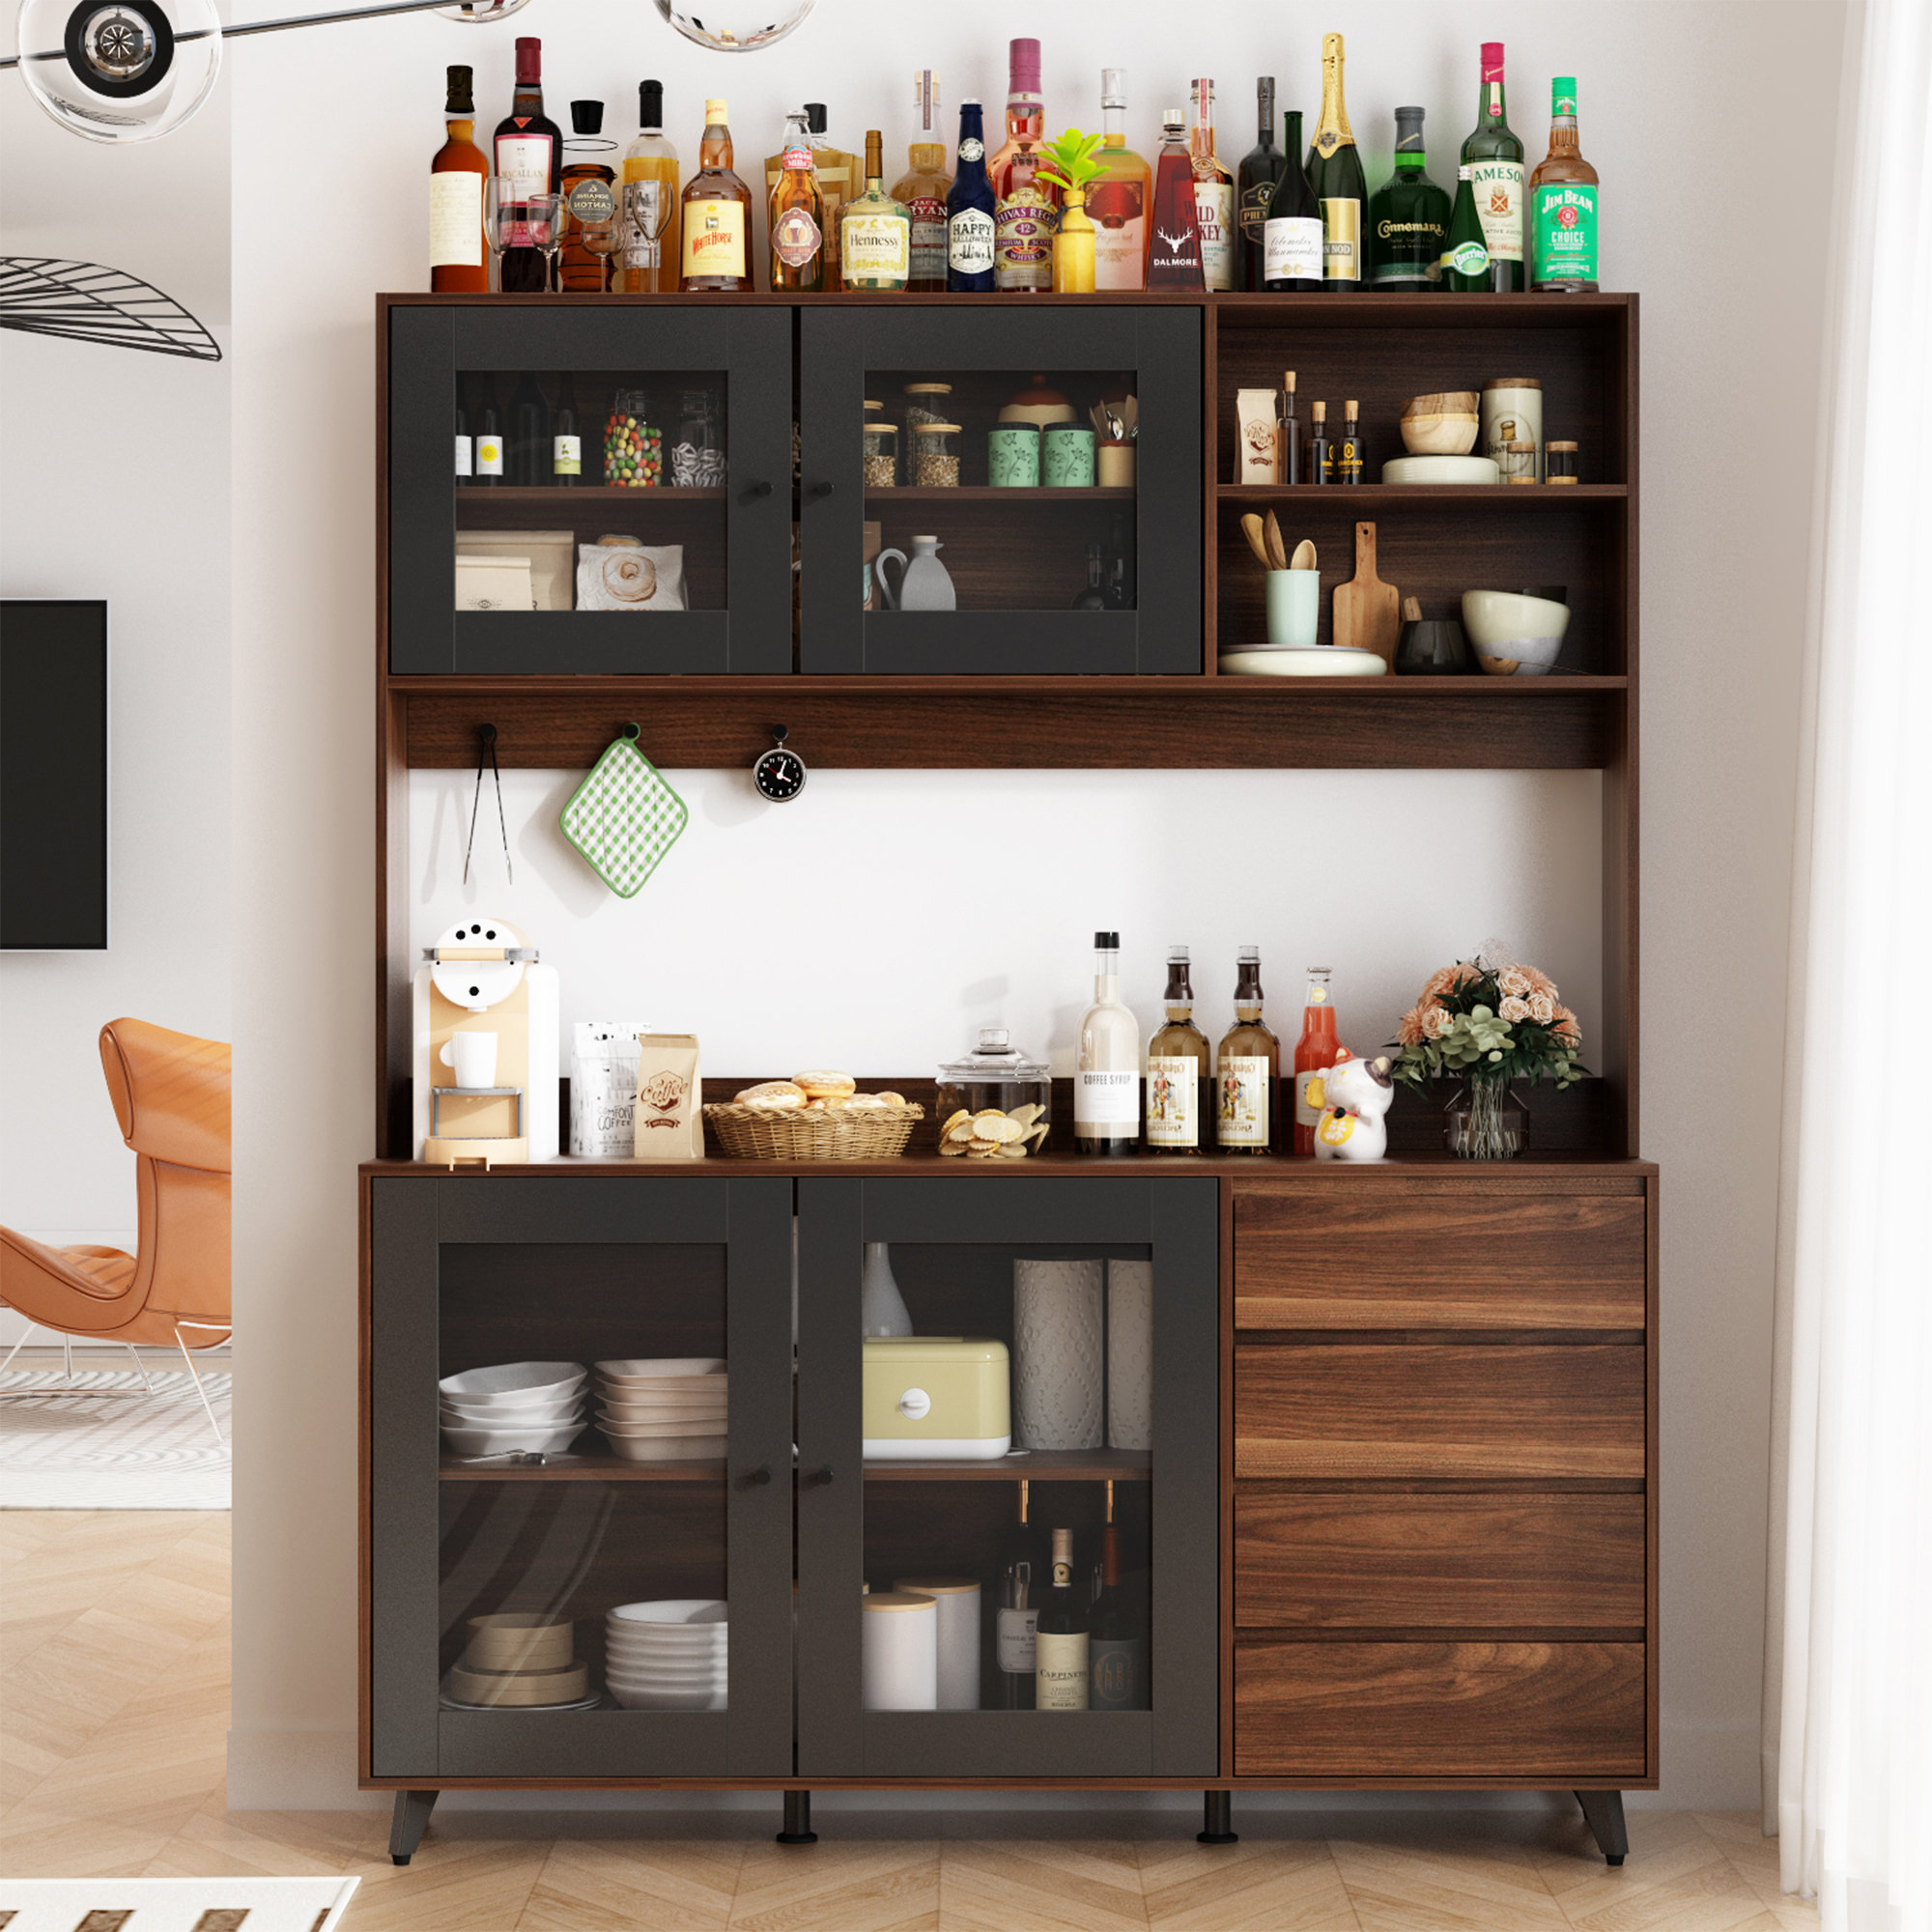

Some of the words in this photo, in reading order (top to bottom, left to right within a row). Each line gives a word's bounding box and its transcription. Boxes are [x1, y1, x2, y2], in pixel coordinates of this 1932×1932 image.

[1473, 166, 1523, 185] AMESO
[1542, 194, 1562, 213] JIM
[1564, 189, 1593, 213] BEAM
[996, 208, 1026, 227] HIVAS
[952, 224, 992, 236] HAPPY
[1020, 224, 1032, 233] 12
[1377, 219, 1445, 240] Connemara
[693, 236, 711, 255] WHITE
[712, 231, 733, 245] HORSE
[850, 234, 899, 249] Hennessy
[1551, 231, 1585, 243] CHOICE
[1010, 252, 1041, 262] WHISKY
[1332, 244, 1351, 255] NOD
[1153, 258, 1199, 268] DALMORE
[1083, 1074, 1108, 1086] COFFEE
[1109, 1074, 1131, 1086] SYRUP
[640, 1079, 689, 1103] Coffee
[597, 1116, 631, 1131] COFFEE
